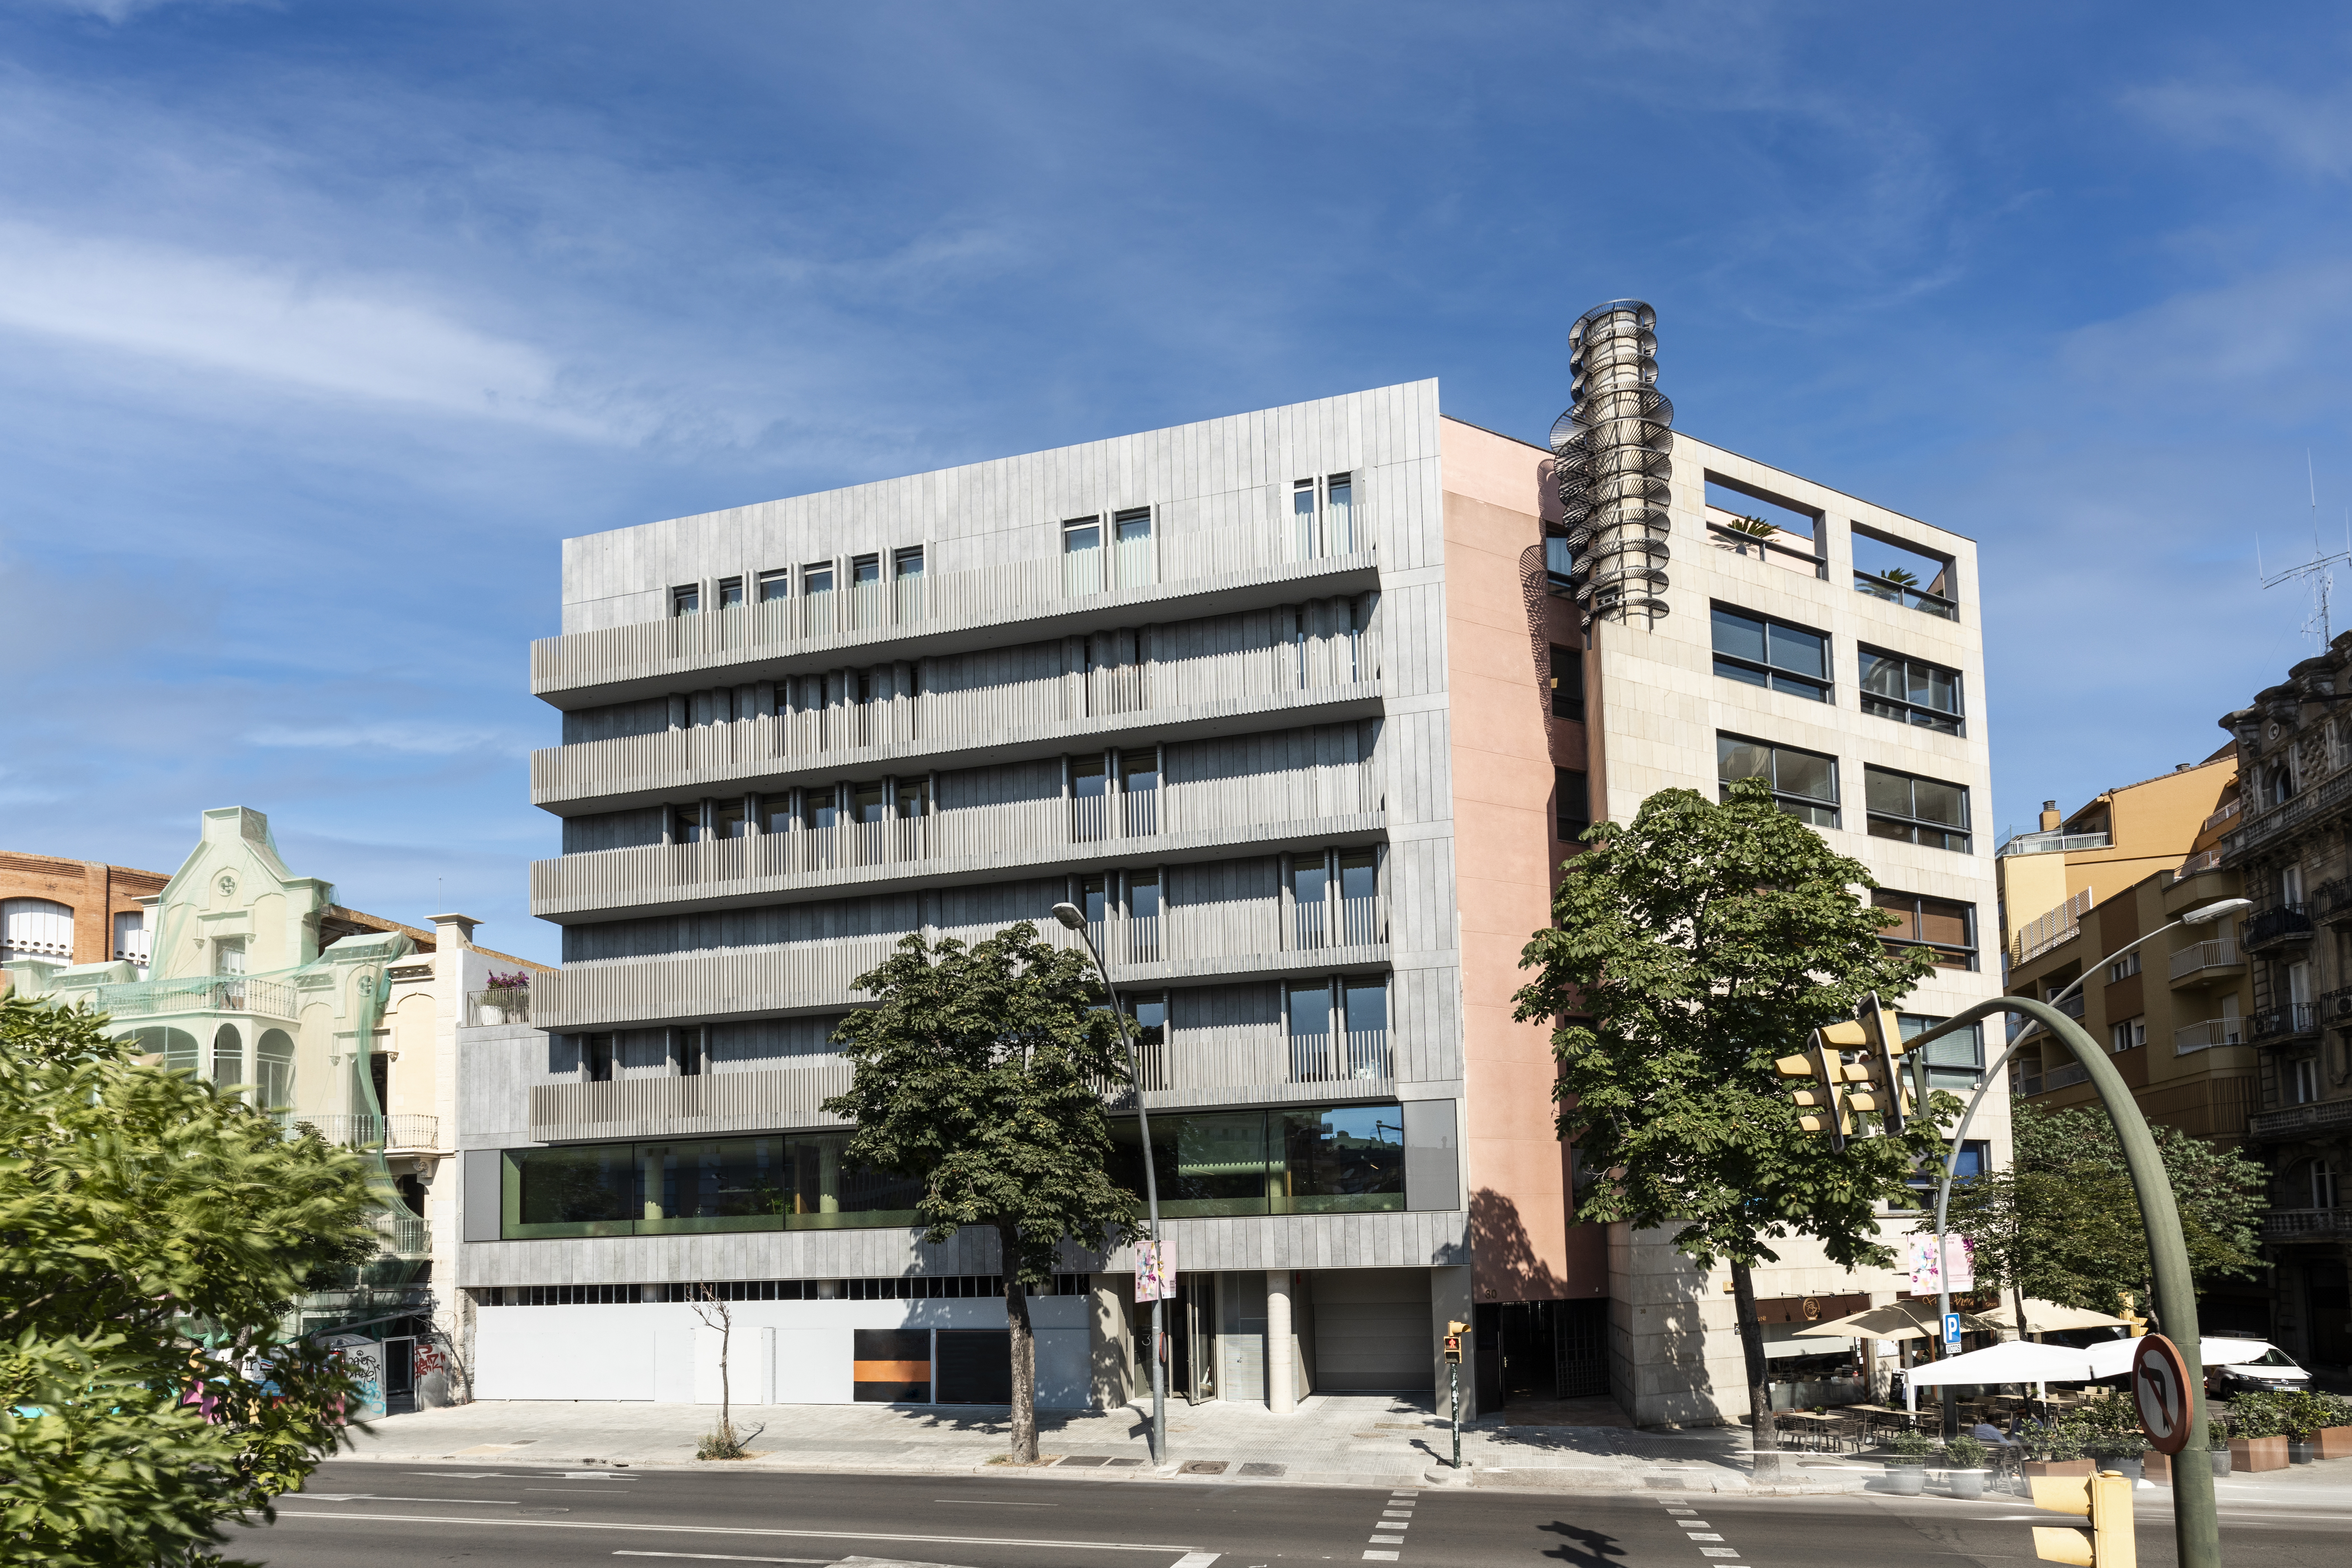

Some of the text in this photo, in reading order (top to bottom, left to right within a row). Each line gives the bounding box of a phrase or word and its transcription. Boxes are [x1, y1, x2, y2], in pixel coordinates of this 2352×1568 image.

[1485, 1289, 1497, 1299] 30
[1947, 1317, 1957, 1340] P
[1142, 1334, 1153, 1346] 3
